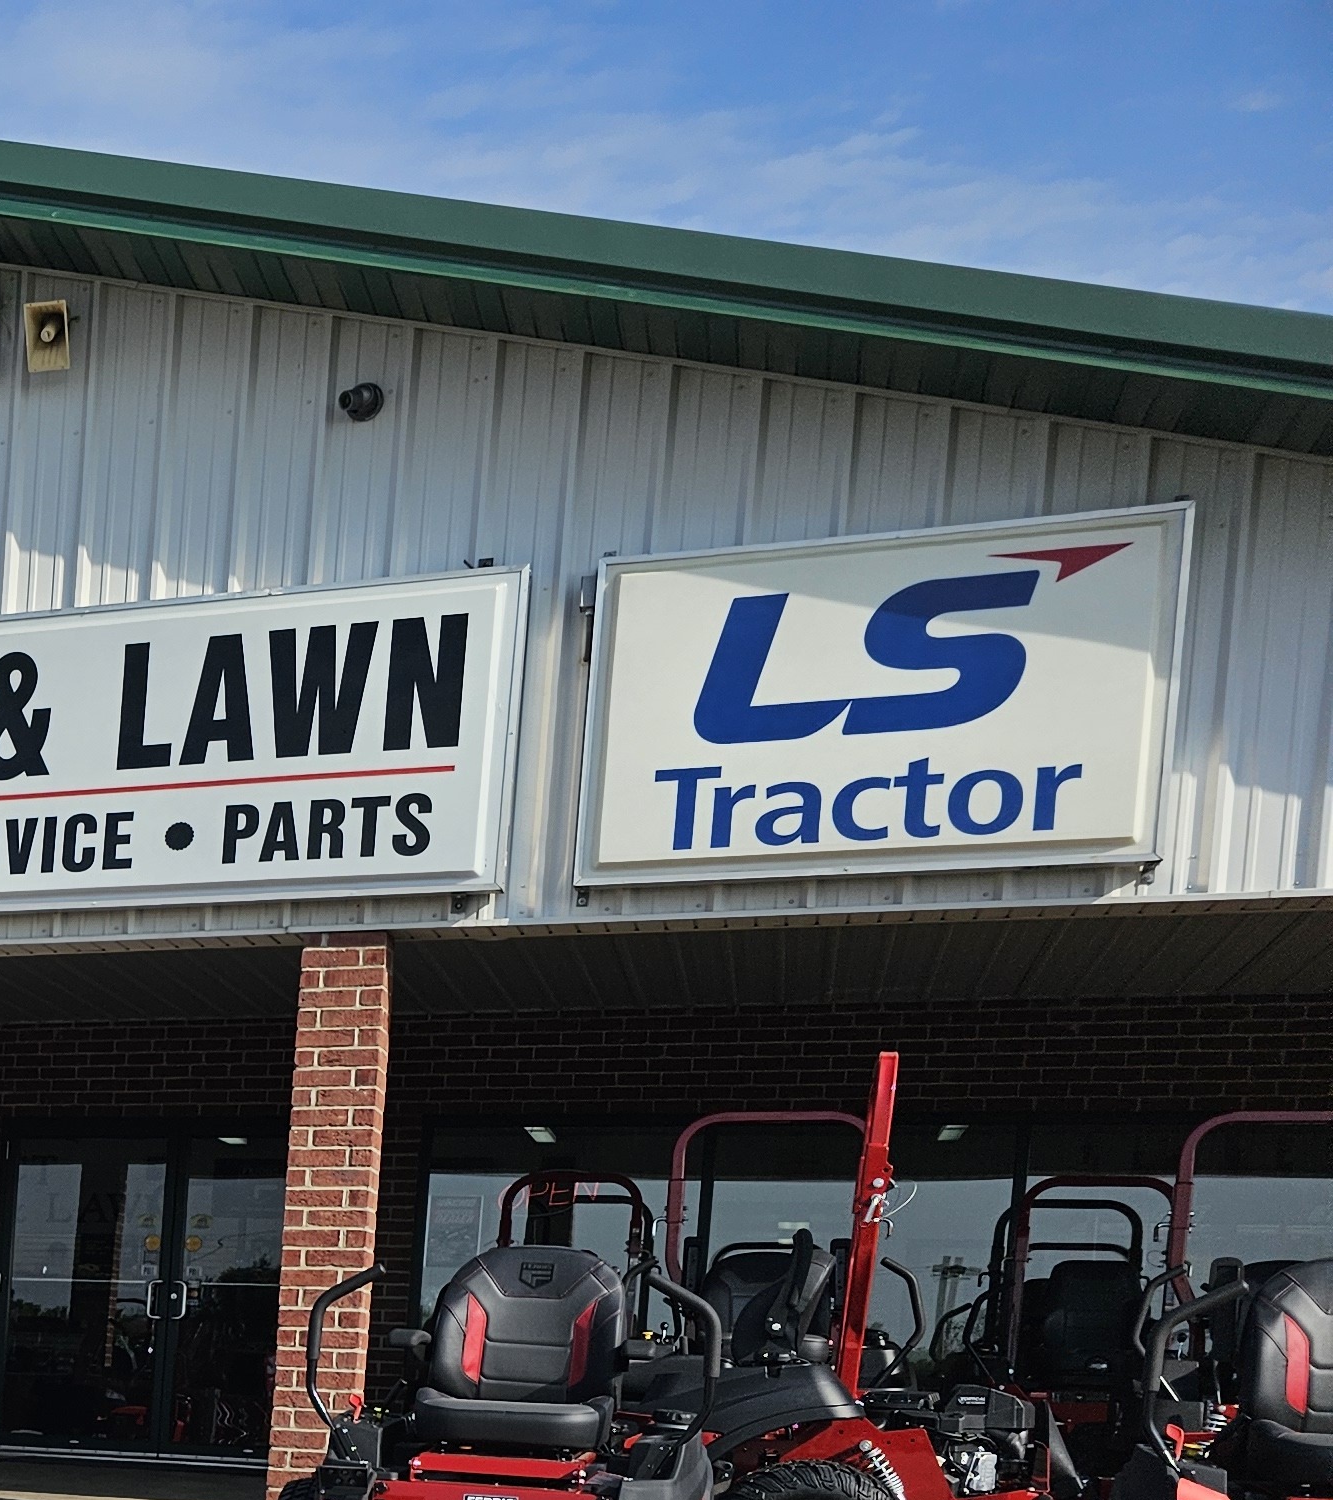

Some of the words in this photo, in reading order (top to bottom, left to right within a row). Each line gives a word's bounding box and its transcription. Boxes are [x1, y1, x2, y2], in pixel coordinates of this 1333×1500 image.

[116, 612, 470, 771] LAWN
[693, 570, 1040, 745] LS
[221, 792, 433, 865] PARTS
[654, 757, 1083, 851] Tractor
[497, 1181, 600, 1212] OPEN
